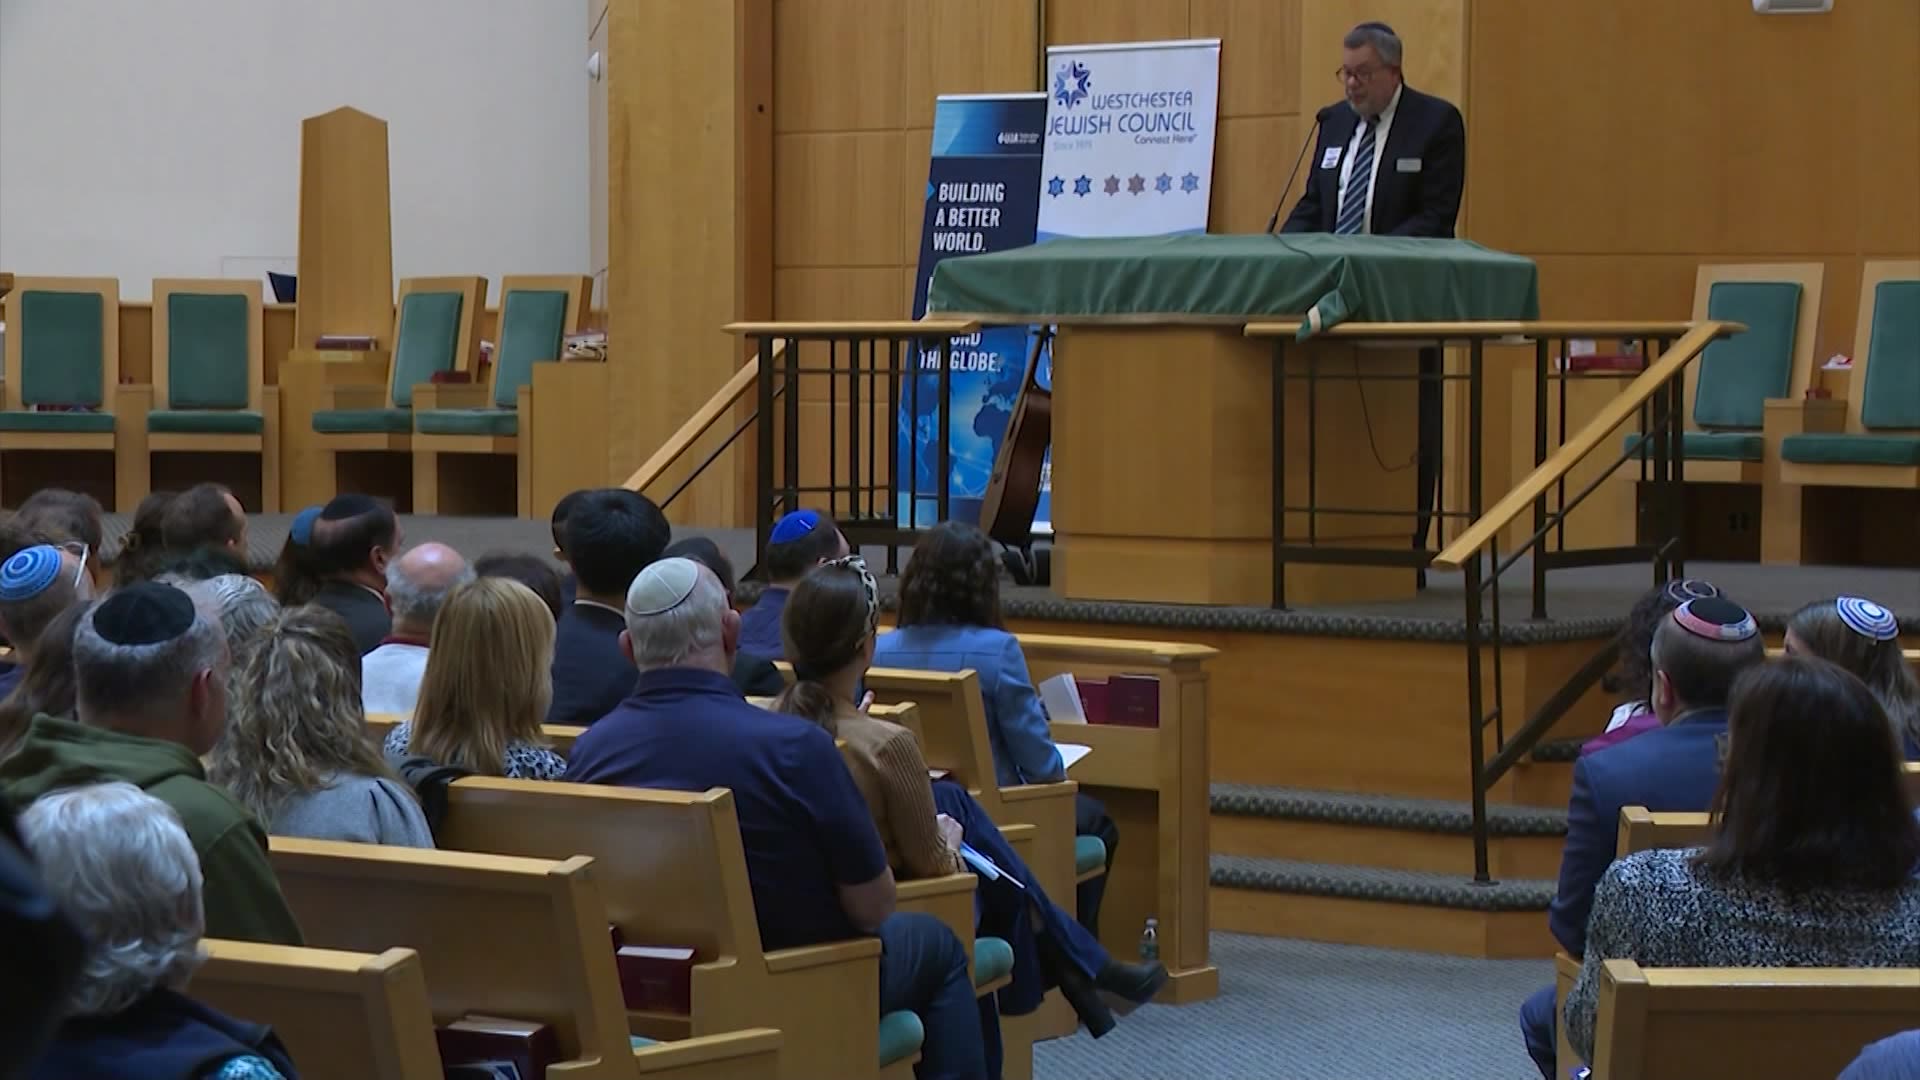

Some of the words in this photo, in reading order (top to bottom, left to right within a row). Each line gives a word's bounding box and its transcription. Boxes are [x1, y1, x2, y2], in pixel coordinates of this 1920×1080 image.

[1092, 91, 1193, 110] WESTCHESTER
[1048, 114, 1112, 136] JEWISH
[1118, 112, 1196, 133] COUNCIL
[1134, 134, 1170, 145] Connect
[938, 183, 1005, 203] BUILDING
[935, 208, 945, 227] A
[948, 208, 1001, 228] BETTER
[933, 232, 987, 252] WORLD.
